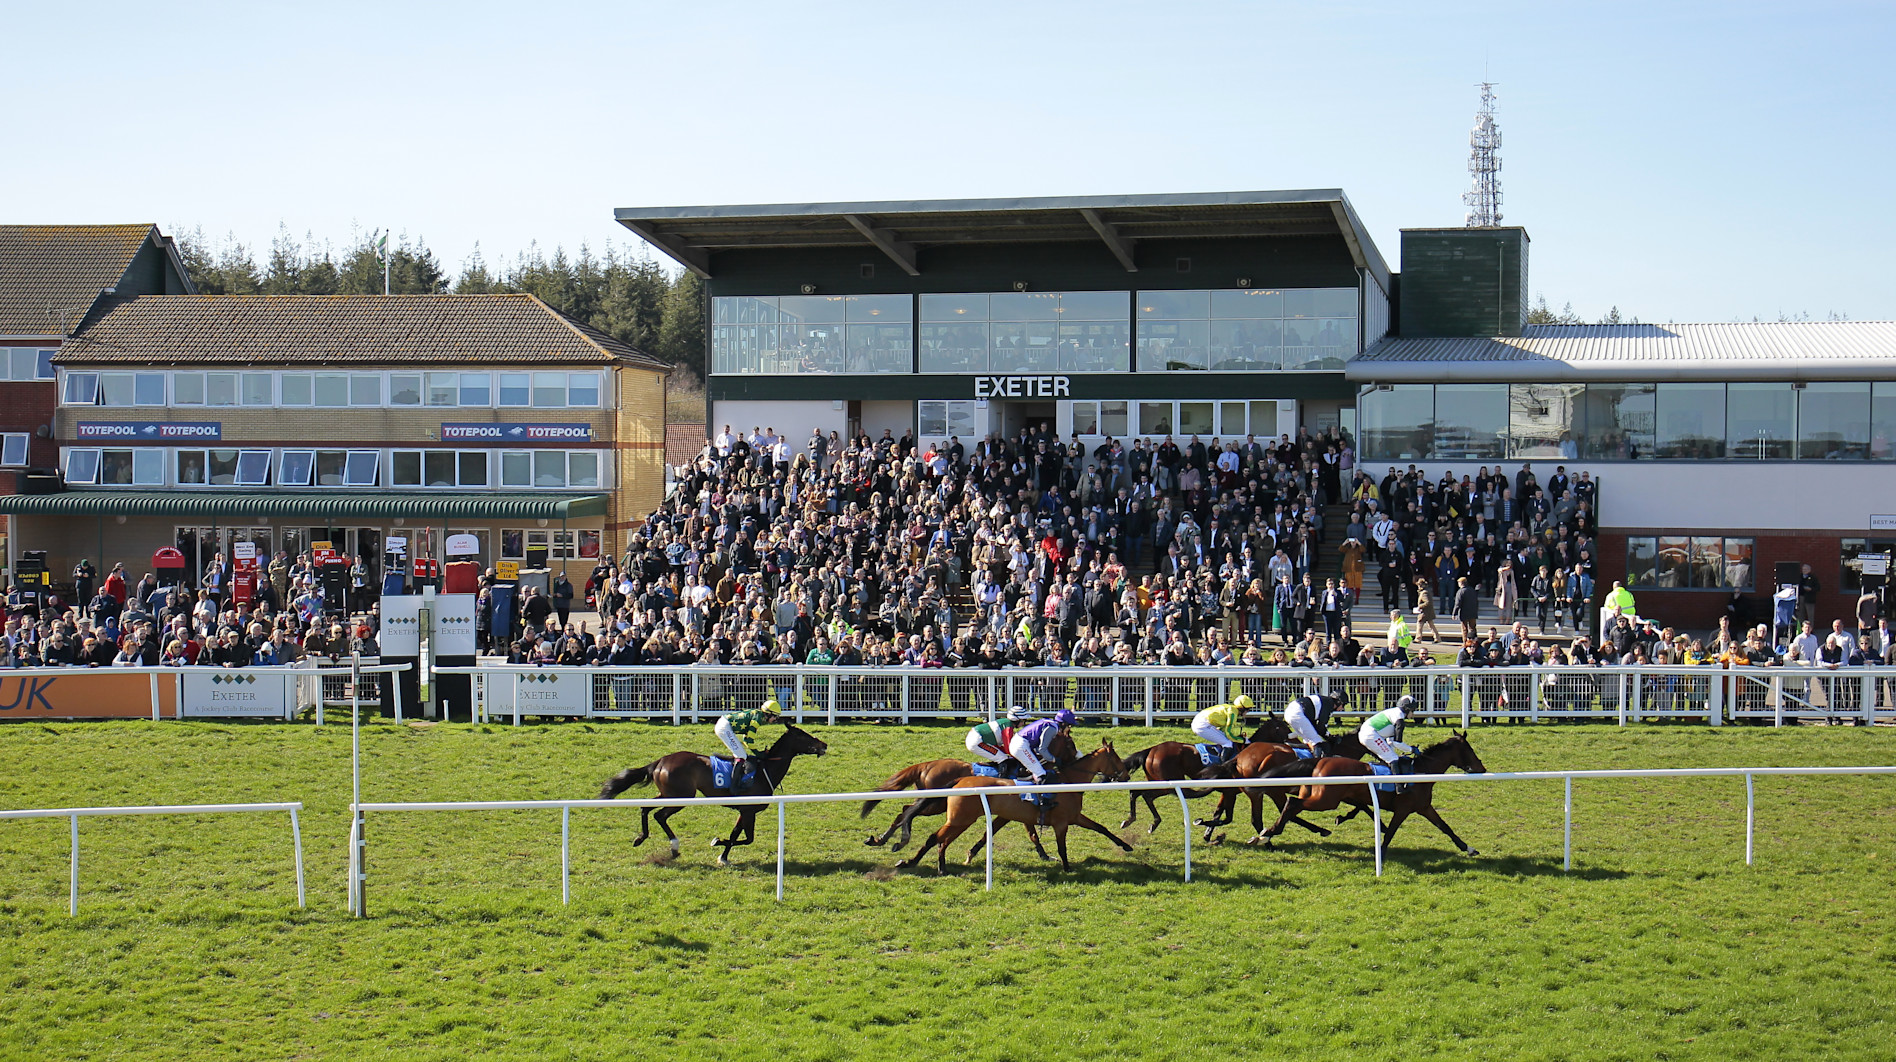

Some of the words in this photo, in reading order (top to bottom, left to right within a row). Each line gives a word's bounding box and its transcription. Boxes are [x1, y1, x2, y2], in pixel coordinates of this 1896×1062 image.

[975, 376, 1070, 397] EXETER
[80, 426, 136, 435] TOTEPOOL
[162, 426, 218, 436] TOTEPOOL
[444, 427, 502, 437] TOTEPOOL
[529, 428, 588, 437] TOTEPOOL
[0, 678, 56, 710] UK
[212, 690, 256, 701] EXETER
[1023, 749, 1036, 764] 32Red
[715, 773, 724, 786] 6
